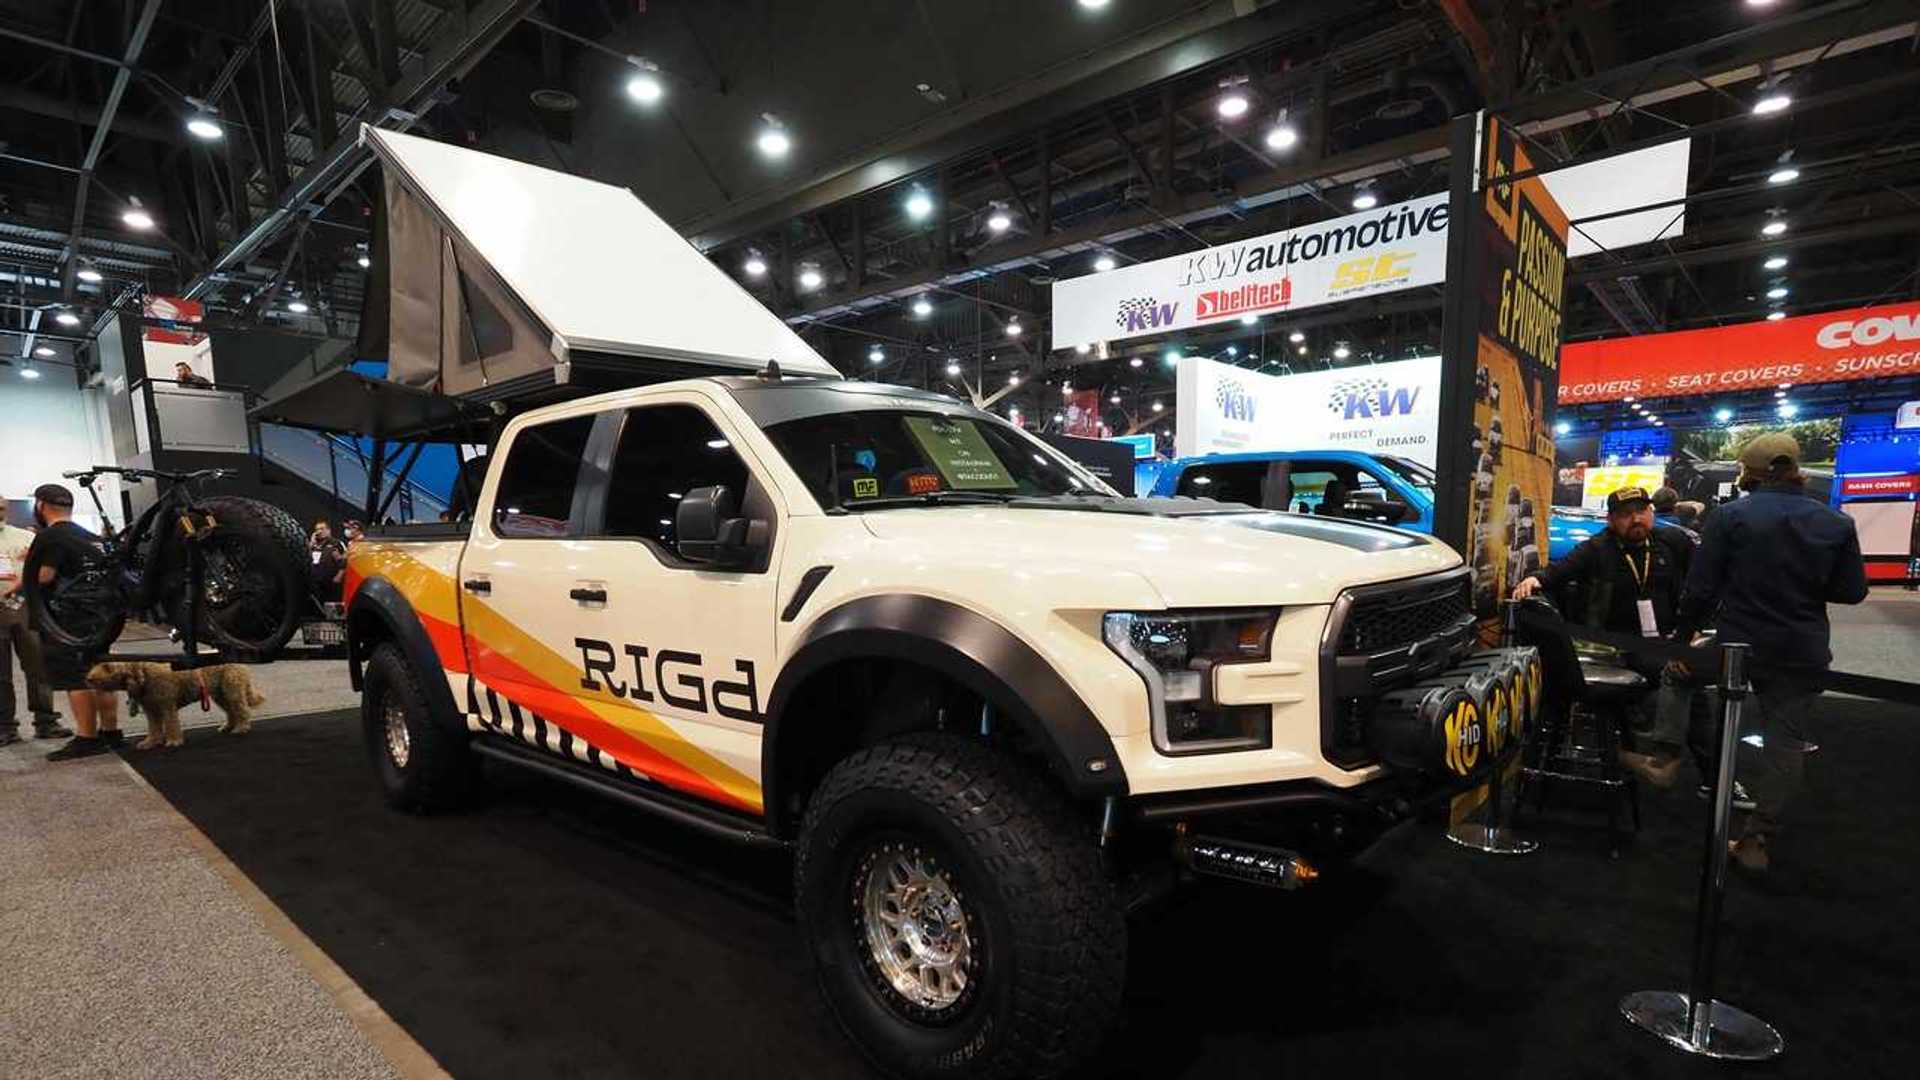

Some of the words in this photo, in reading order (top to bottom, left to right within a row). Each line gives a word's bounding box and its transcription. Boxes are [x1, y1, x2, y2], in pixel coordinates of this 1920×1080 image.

[1518, 210, 1566, 312] PASSION
[1126, 301, 1180, 332] KW
[1510, 278, 1561, 370] PURPOSE
[1572, 379, 1642, 396] COVERS
[1666, 372, 1716, 389] SEAT
[1720, 363, 1804, 384] COVERS
[1343, 385, 1421, 420] KW
[1459, 724, 1480, 745] HID
